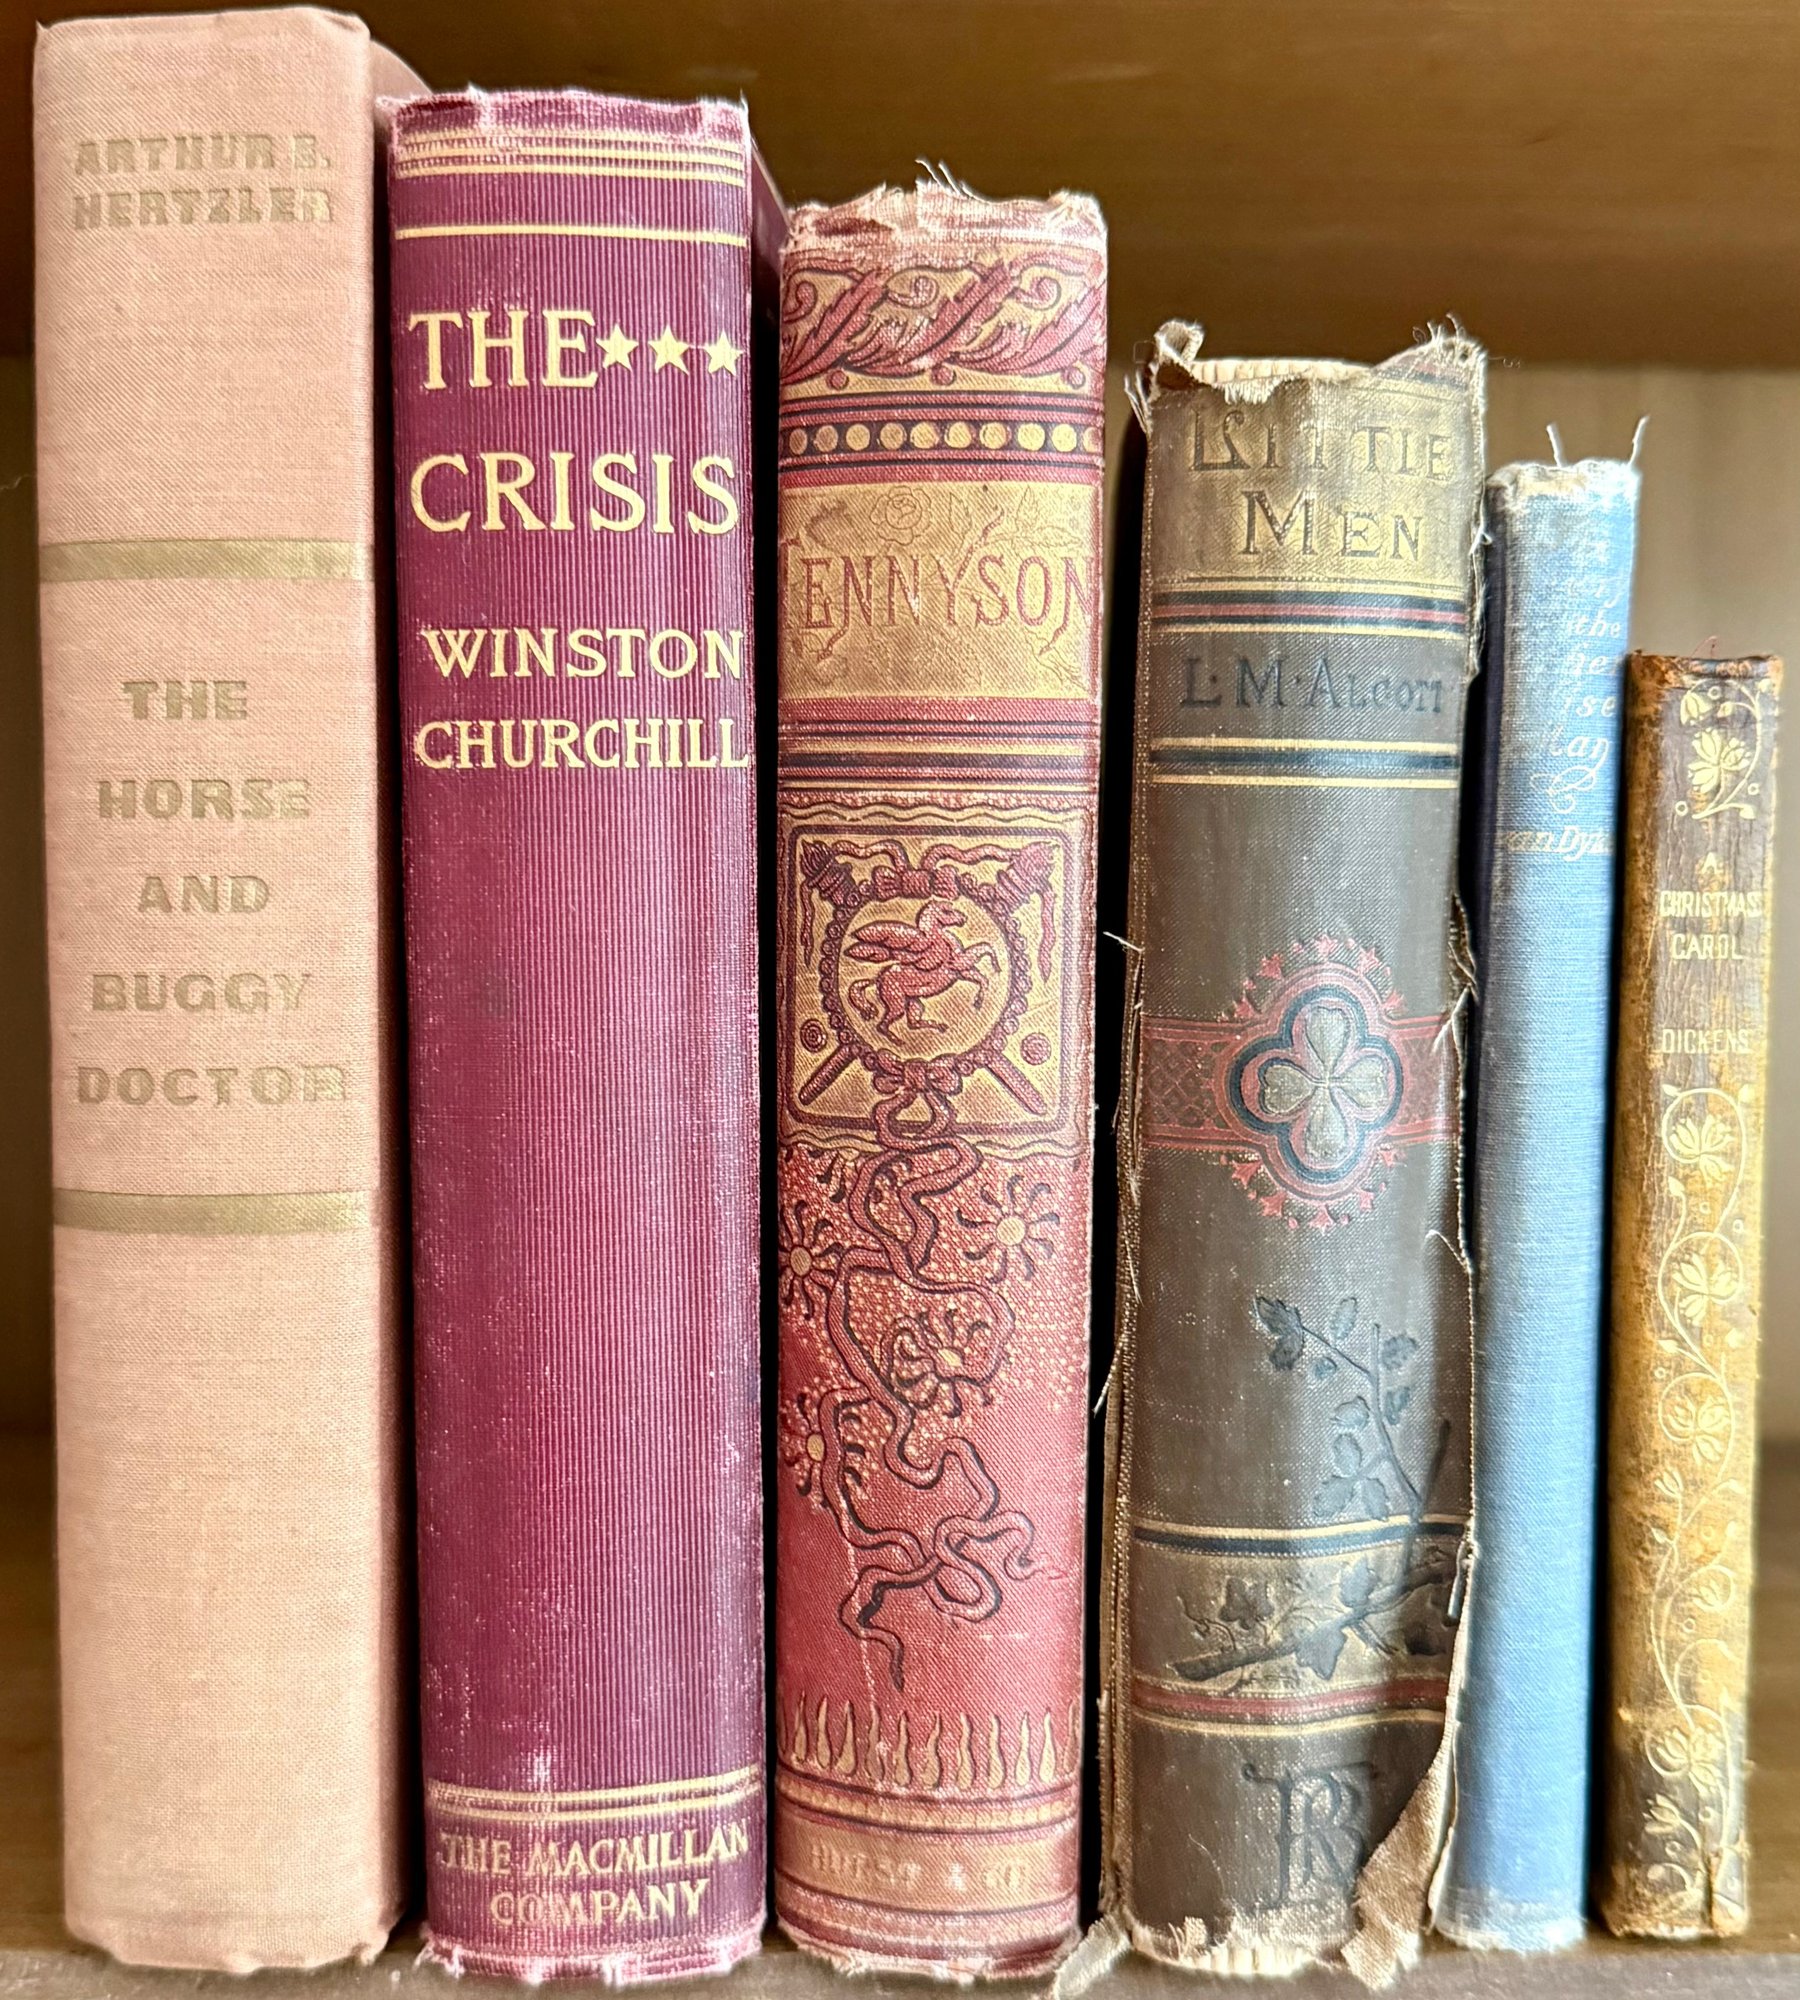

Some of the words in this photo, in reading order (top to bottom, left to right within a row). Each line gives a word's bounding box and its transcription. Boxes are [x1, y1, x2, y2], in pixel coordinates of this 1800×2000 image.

[75, 134, 275, 175] ARTHUR
[74, 187, 334, 230] HERTZLER
[409, 309, 599, 390] THE
[410, 452, 740, 535] CRISIS
[1240, 490, 1422, 562] MEN
[420, 626, 745, 680] WINSTON
[122, 680, 247, 721] THE
[413, 718, 750, 770] CHURCHILL
[97, 779, 311, 820] HORSE
[137, 874, 270, 913] AND
[1659, 890, 1764, 918] CHRISTMAS
[1671, 933, 1744, 960] CAROL
[91, 973, 312, 1013] BUGGY
[1662, 1028, 1751, 1054] DICKENS
[76, 1064, 347, 1107] DOCTOR
[440, 1832, 512, 1875] THE
[526, 1818, 749, 1877] MACMILLAN
[490, 1879, 710, 1926] COMPANY
